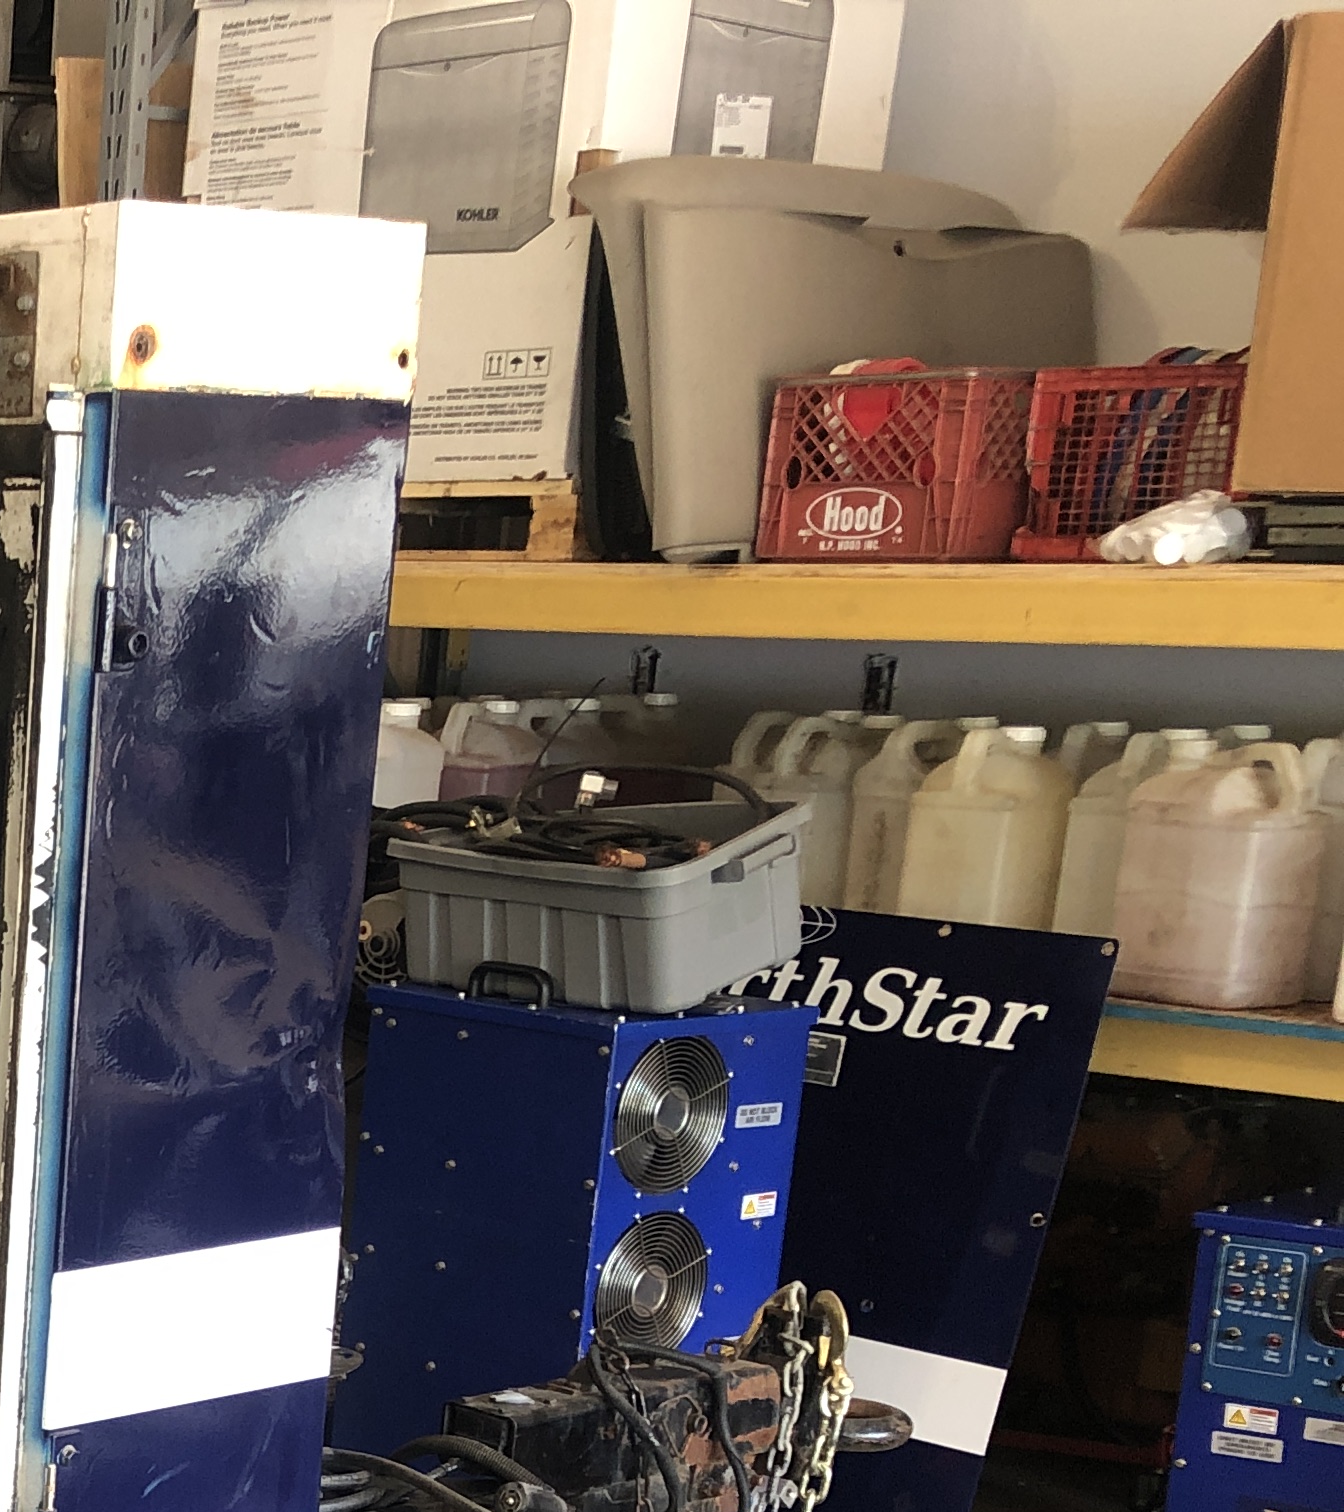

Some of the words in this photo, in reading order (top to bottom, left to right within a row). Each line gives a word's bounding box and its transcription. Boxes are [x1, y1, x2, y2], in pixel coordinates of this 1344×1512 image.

[456, 207, 499, 222] KOHLER
[823, 495, 886, 531] Hood
[837, 540, 861, 551] HOOD
[726, 957, 1049, 1051] rthStar
